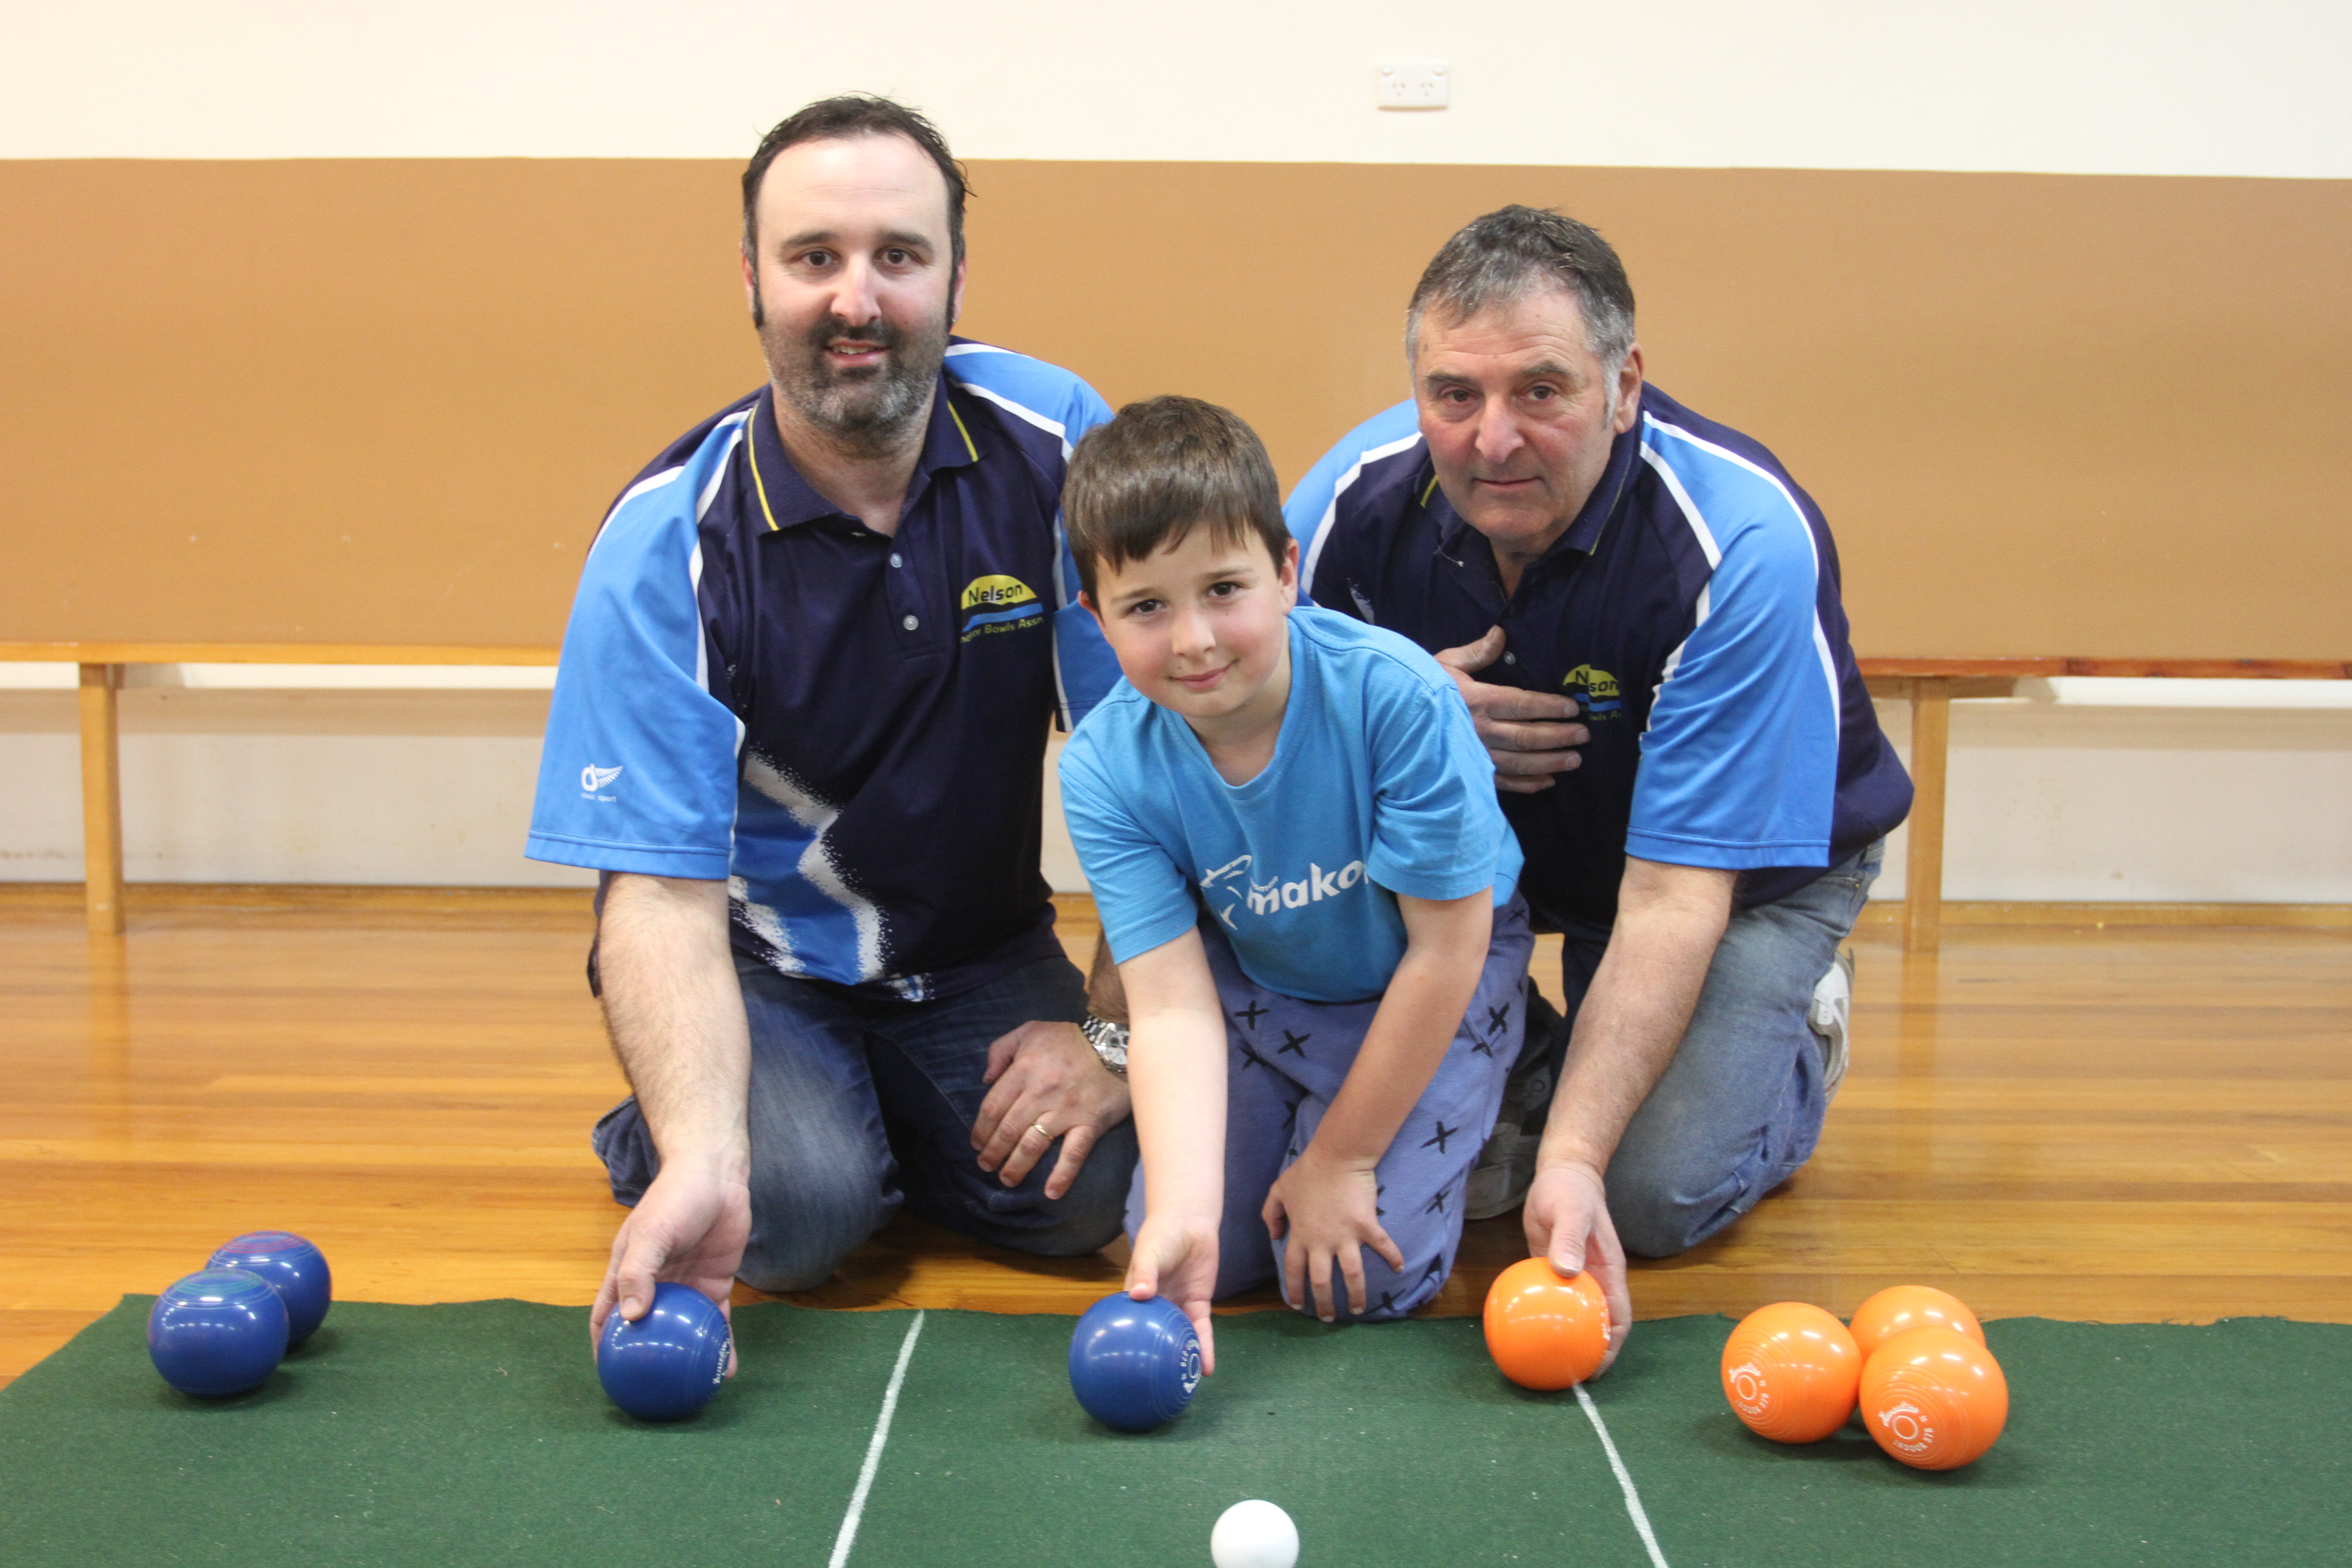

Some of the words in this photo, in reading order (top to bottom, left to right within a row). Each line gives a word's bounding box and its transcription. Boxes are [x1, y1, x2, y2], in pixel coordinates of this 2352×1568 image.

[968, 584, 1023, 606] Nelson
[984, 622, 1015, 634] Bowls
[1018, 617, 1043, 629] Assn
[1575, 670, 1619, 692] Nson
[1247, 860, 1369, 916] mako
